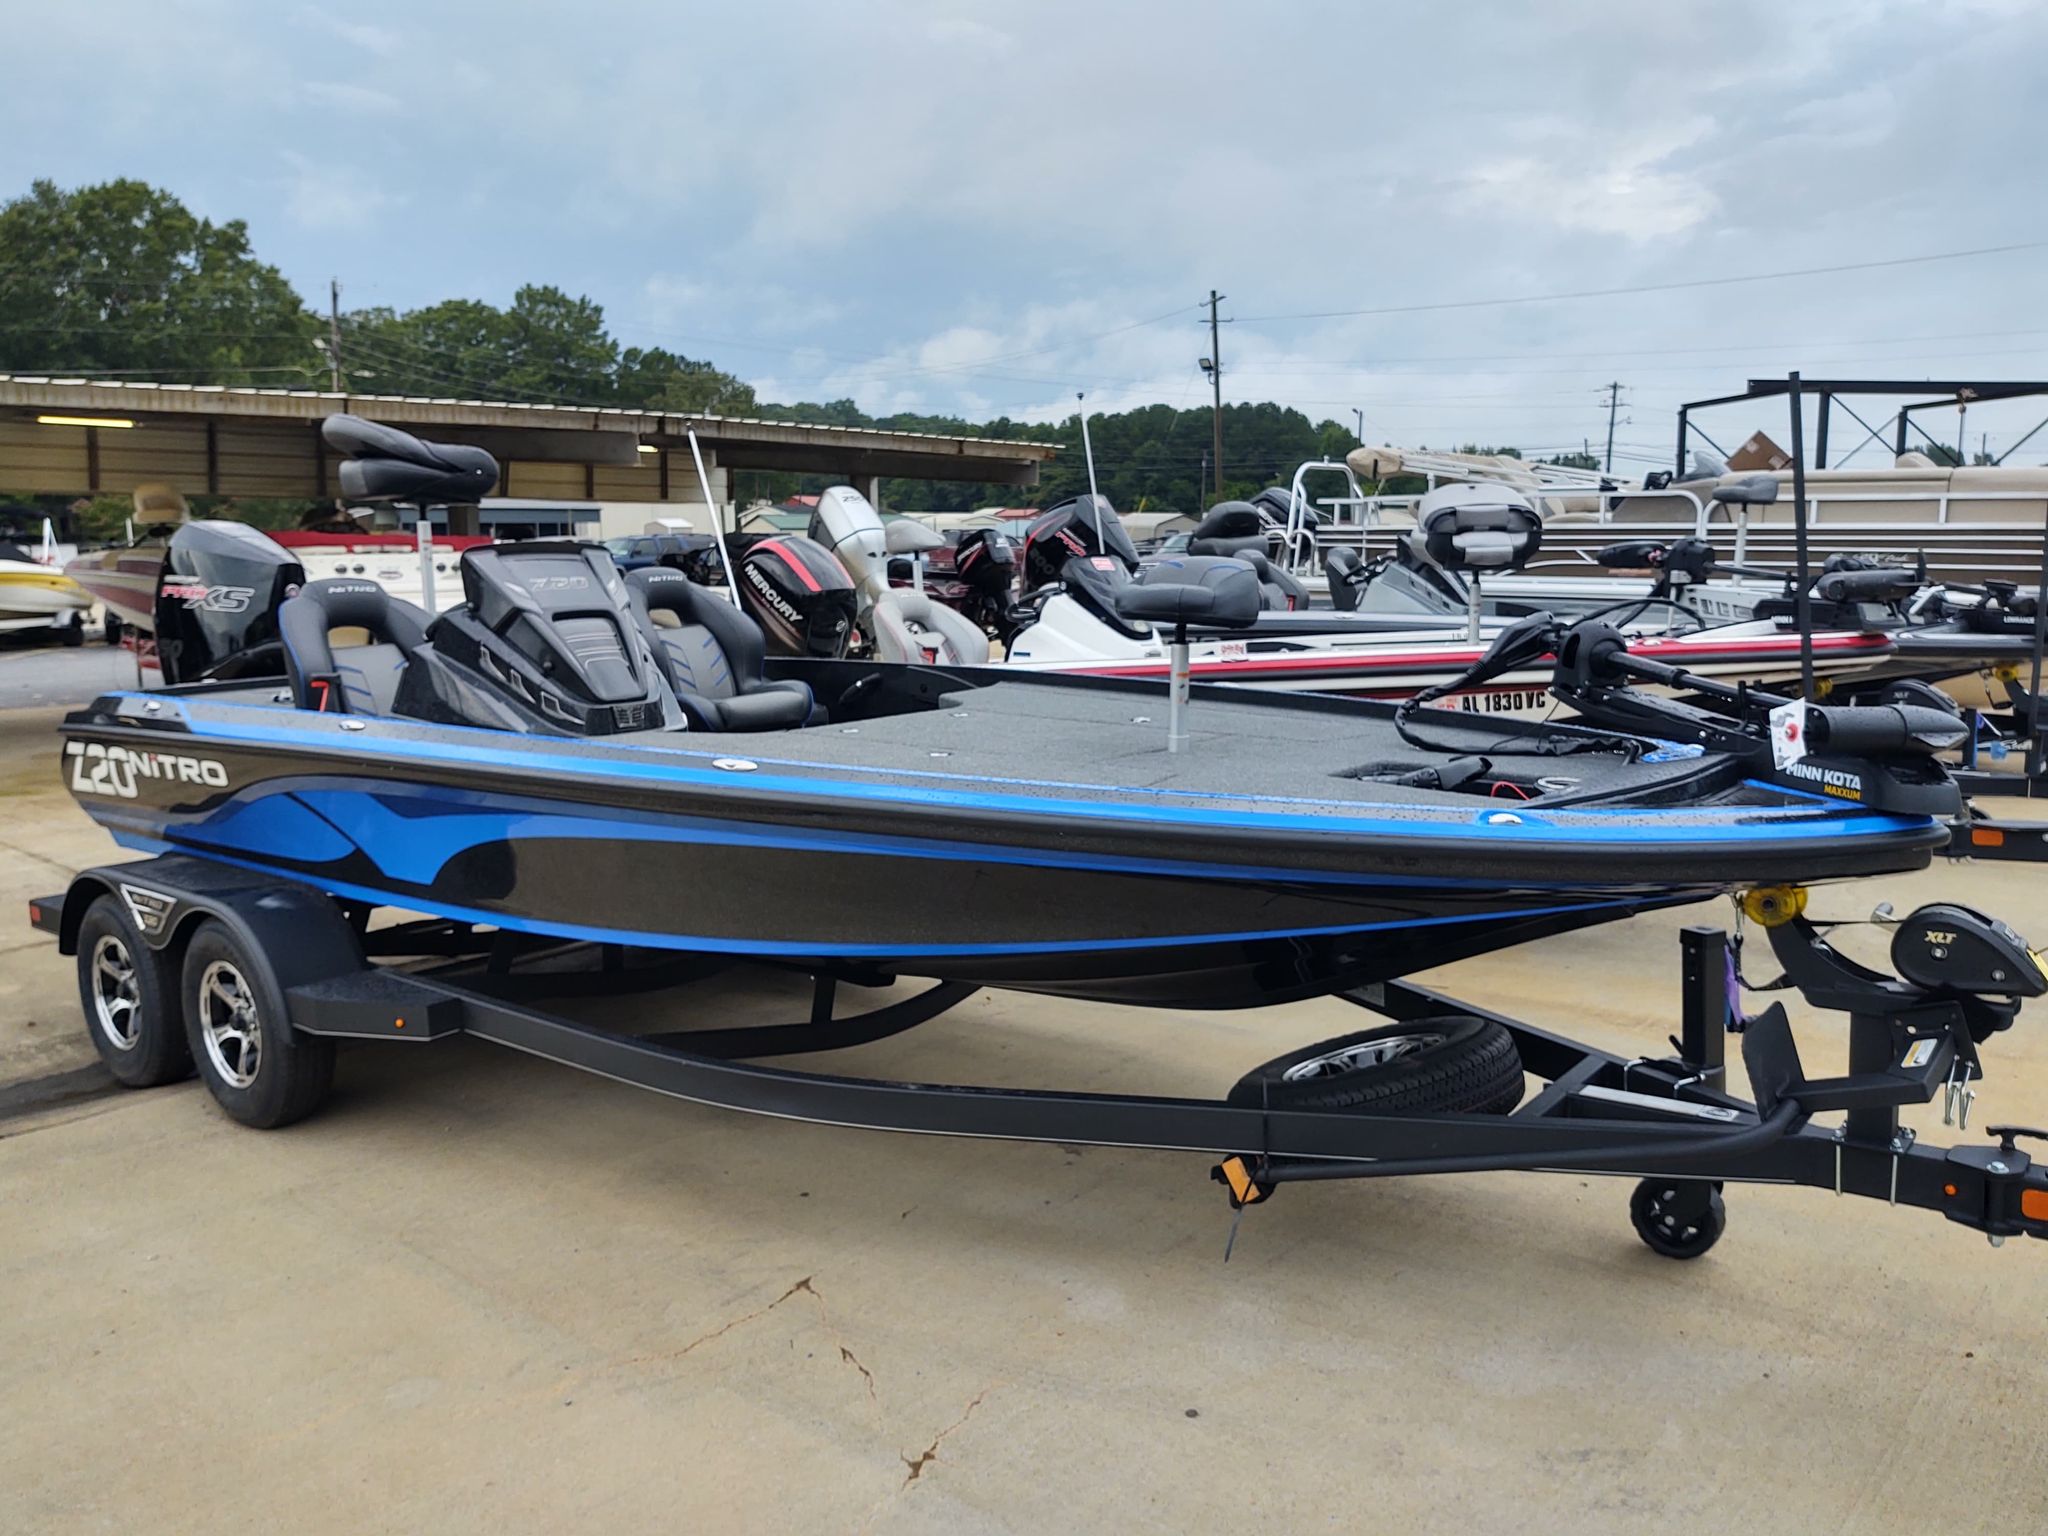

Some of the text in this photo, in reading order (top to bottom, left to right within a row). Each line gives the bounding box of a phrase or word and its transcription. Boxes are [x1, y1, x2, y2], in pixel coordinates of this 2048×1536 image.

[744, 563, 804, 622] MERCURY
[1462, 696, 1480, 713] AL
[1484, 693, 1524, 712] 1830
[1525, 690, 1546, 709] VC
[128, 750, 229, 787] NITRO
[1785, 762, 1862, 791] MINN KOTA
[1824, 785, 1861, 801] MAXXUM
[1924, 930, 1957, 944] XLT
